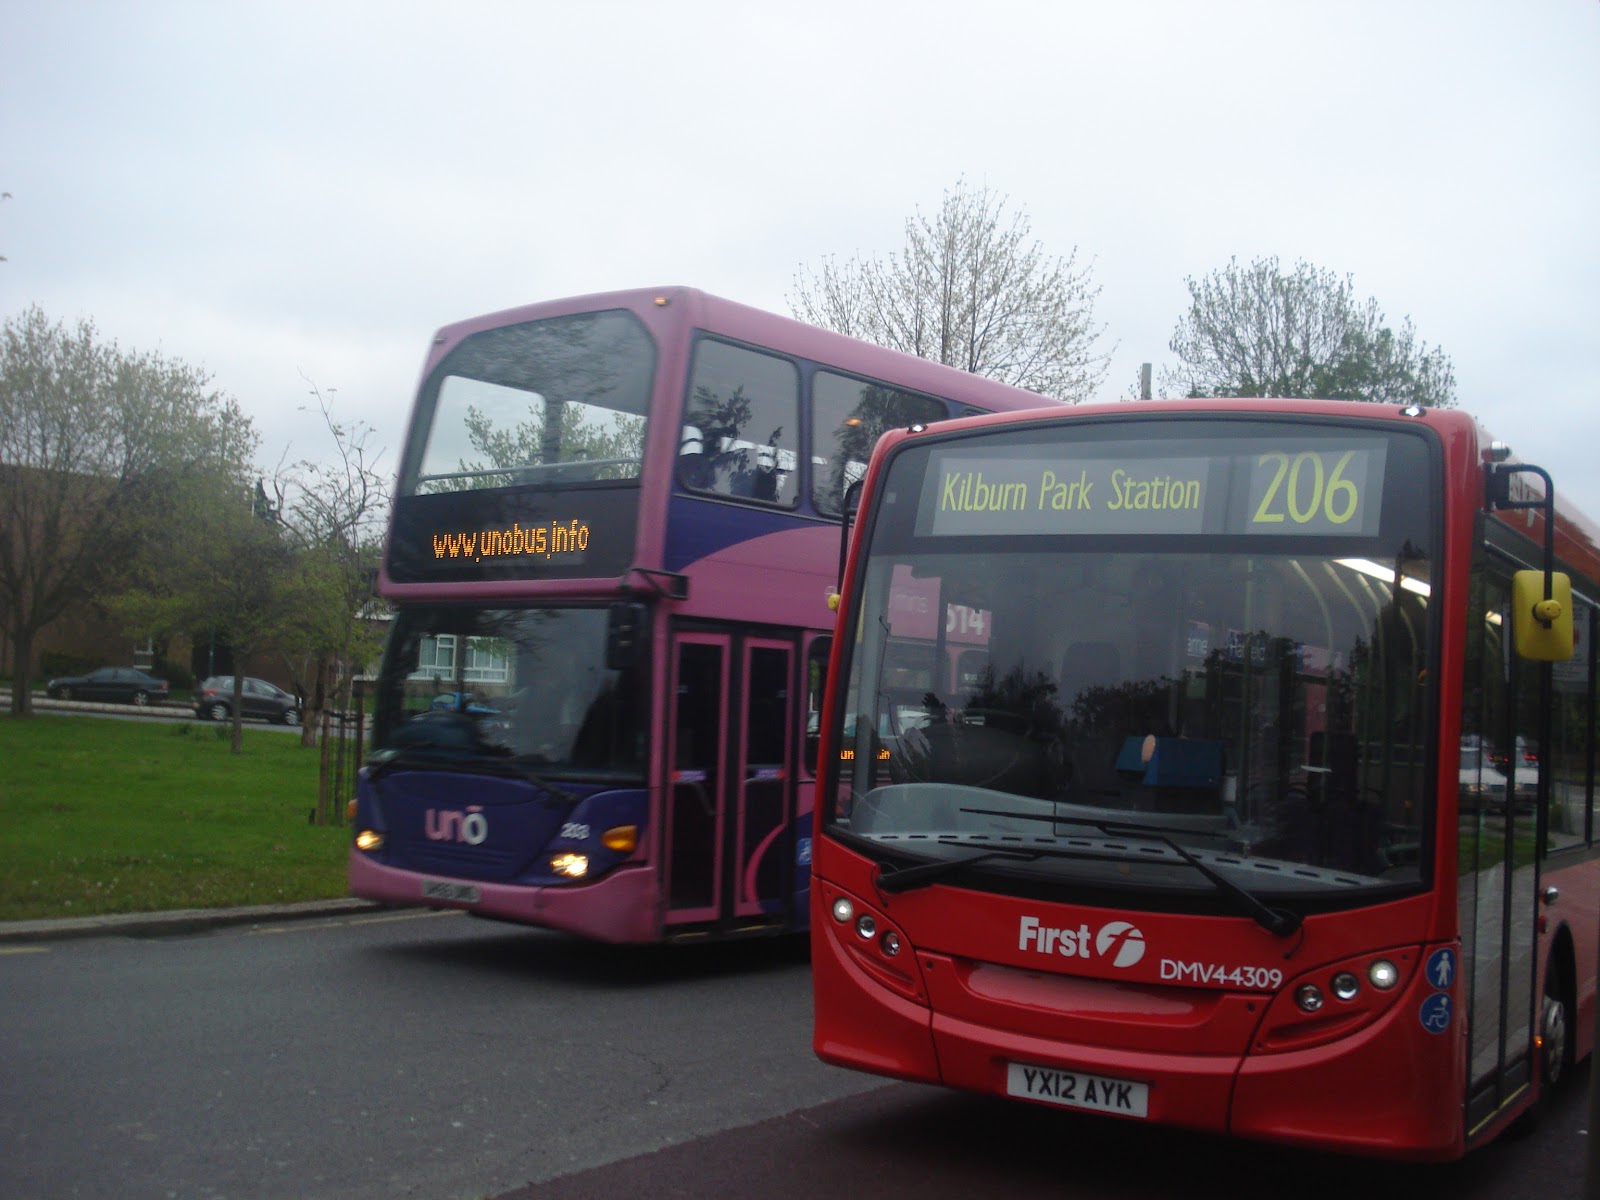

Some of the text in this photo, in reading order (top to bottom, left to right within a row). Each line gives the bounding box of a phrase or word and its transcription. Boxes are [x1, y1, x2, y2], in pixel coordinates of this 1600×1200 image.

[942, 469, 1201, 512] Kilburn Park Station
[1252, 450, 1358, 525] 206
[432, 519, 590, 563] www.unobus.info
[1019, 915, 1091, 958] First
[1160, 959, 1283, 989] DMV44309
[1023, 1067, 1132, 1109] YX12 AYK
